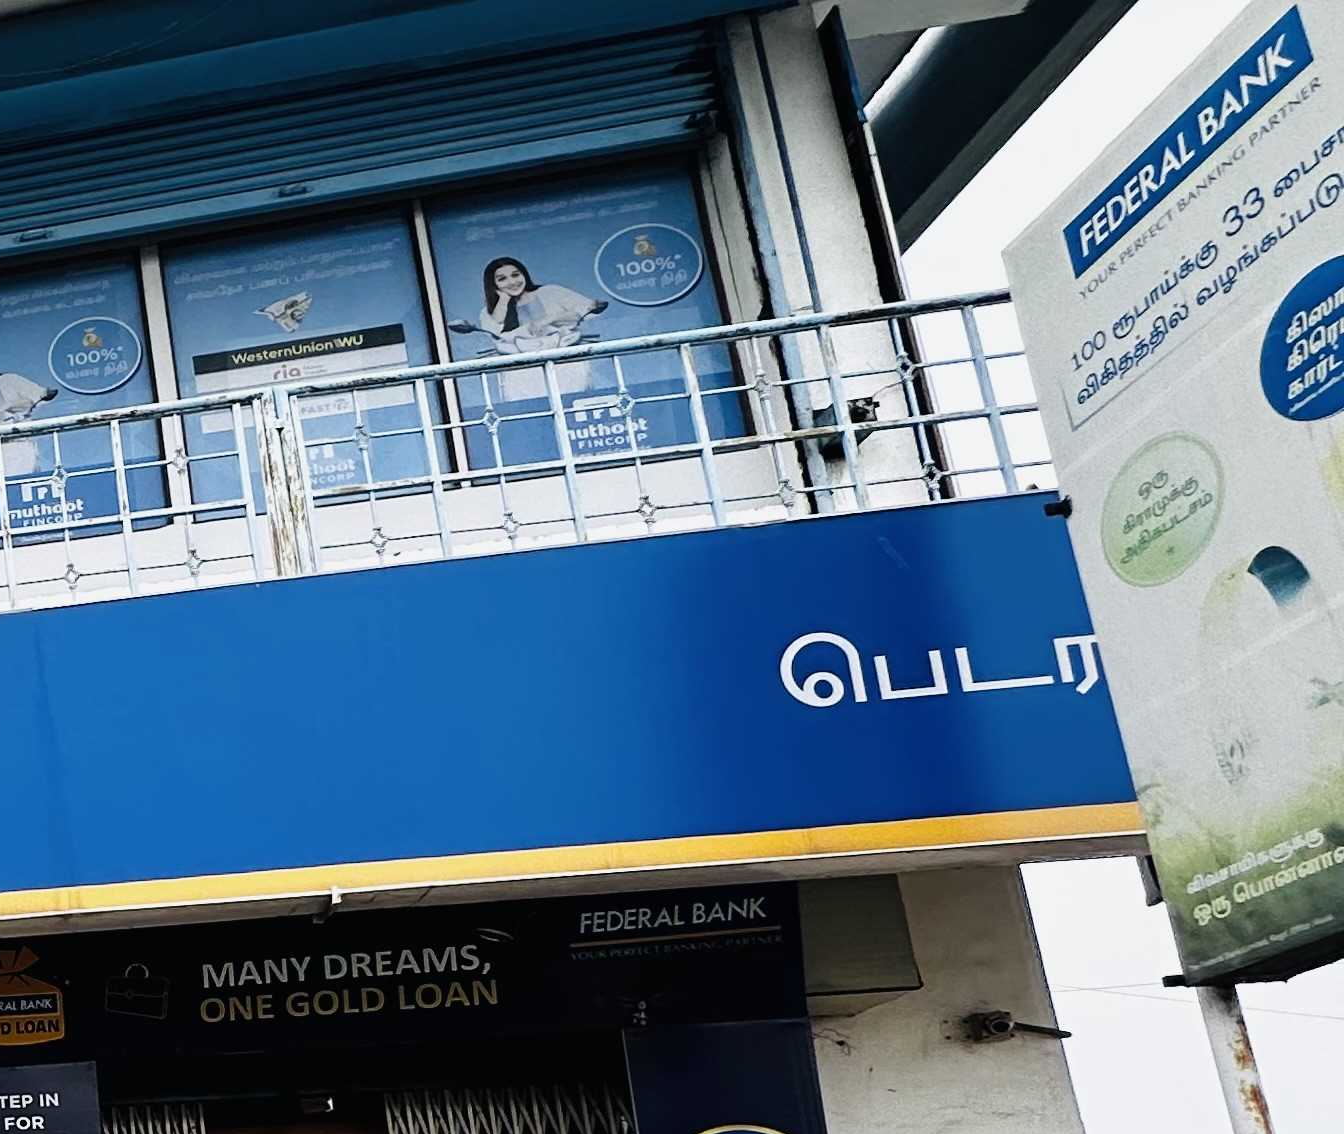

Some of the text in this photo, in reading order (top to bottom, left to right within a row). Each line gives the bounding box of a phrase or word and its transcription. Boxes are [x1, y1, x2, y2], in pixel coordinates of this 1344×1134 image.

[1077, 32, 1295, 258] FEDERAL BANK
[1077, 76, 1323, 299] YOUR PERFECT BANKING PARTNER
[1071, 332, 1107, 373] 100
[1112, 241, 1218, 341] ரூபாய்க்கு
[1223, 186, 1265, 238] 33
[1077, 175, 1344, 406] விகிதத்தில் வழங்கப்படு
[232, 340, 334, 364] WesternUnion
[273, 365, 301, 380] ria
[779, 632, 1104, 707] பெடர
[579, 897, 768, 934] FEDERAL BANK
[1193, 896, 1231, 926] ஒரு
[202, 944, 492, 989] MANY DREAMS,
[21, 999, 53, 1011] BANK
[200, 980, 499, 1023] ONE GOLD LOAN
[16, 1019, 60, 1034] LOAN
[38, 1093, 59, 1108] IN
[3, 1116, 45, 1131] FOR
